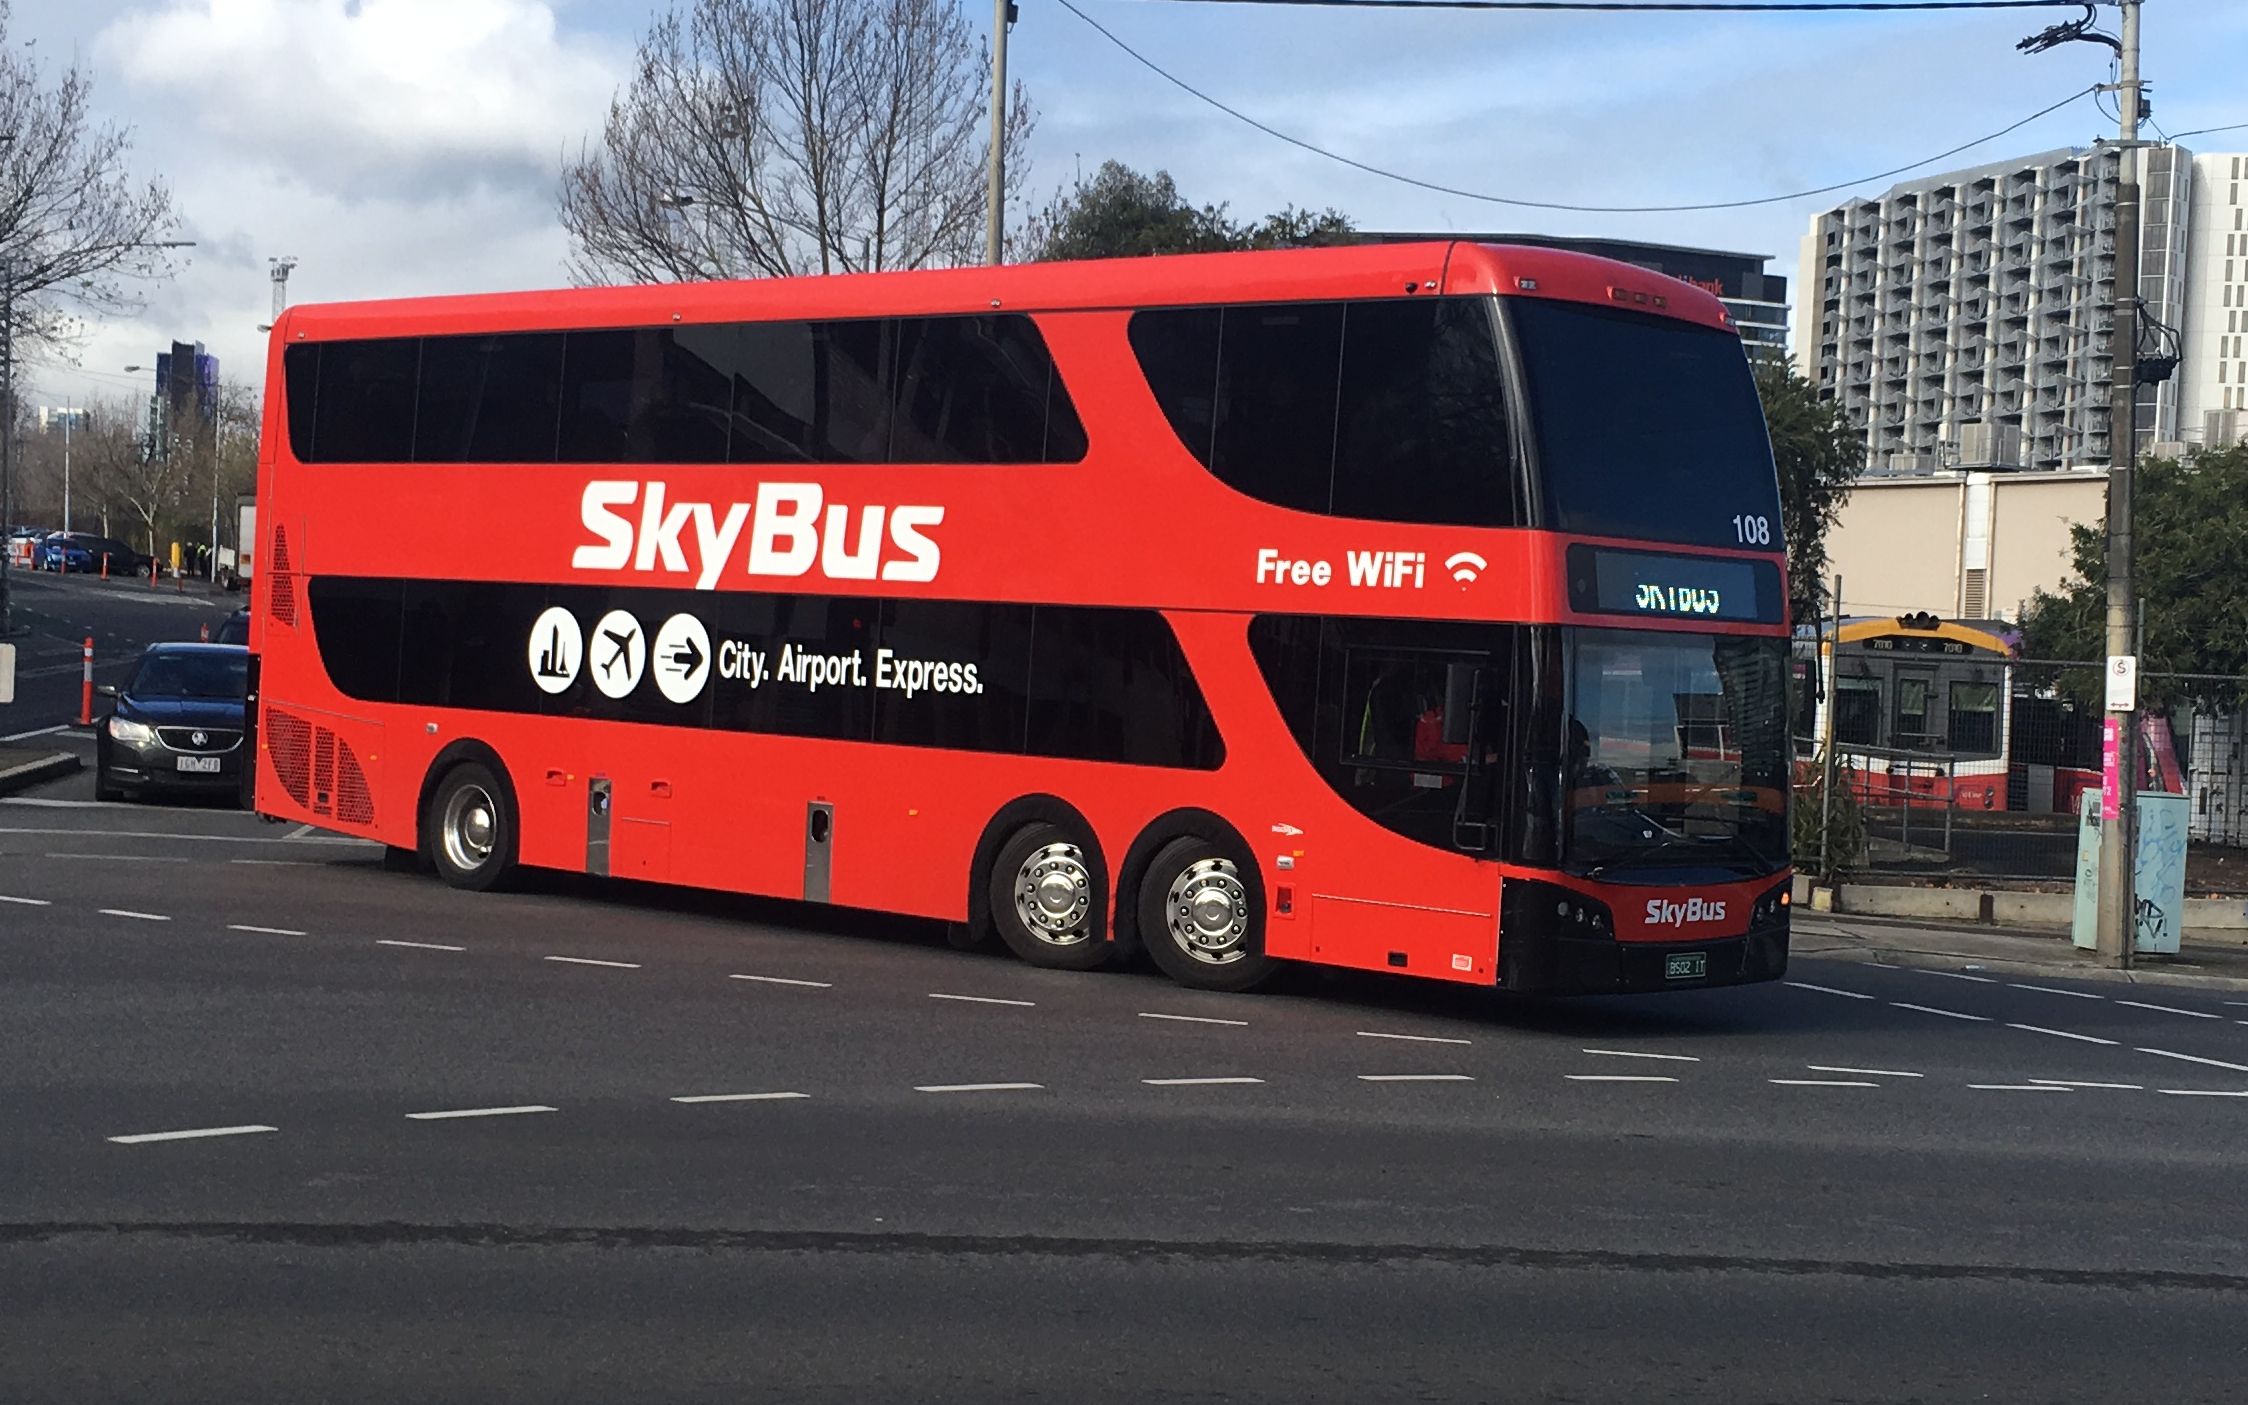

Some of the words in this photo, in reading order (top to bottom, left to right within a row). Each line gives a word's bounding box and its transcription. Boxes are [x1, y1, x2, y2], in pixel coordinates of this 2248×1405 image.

[571, 480, 945, 590] SkyBus
[1732, 514, 1770, 545] 108
[1256, 548, 1332, 586] Free
[1347, 550, 1426, 588] WiFi
[719, 640, 770, 689] City.
[777, 643, 867, 691] Airport.
[876, 648, 984, 699] Express.
[1644, 898, 1726, 928] SkyBus
